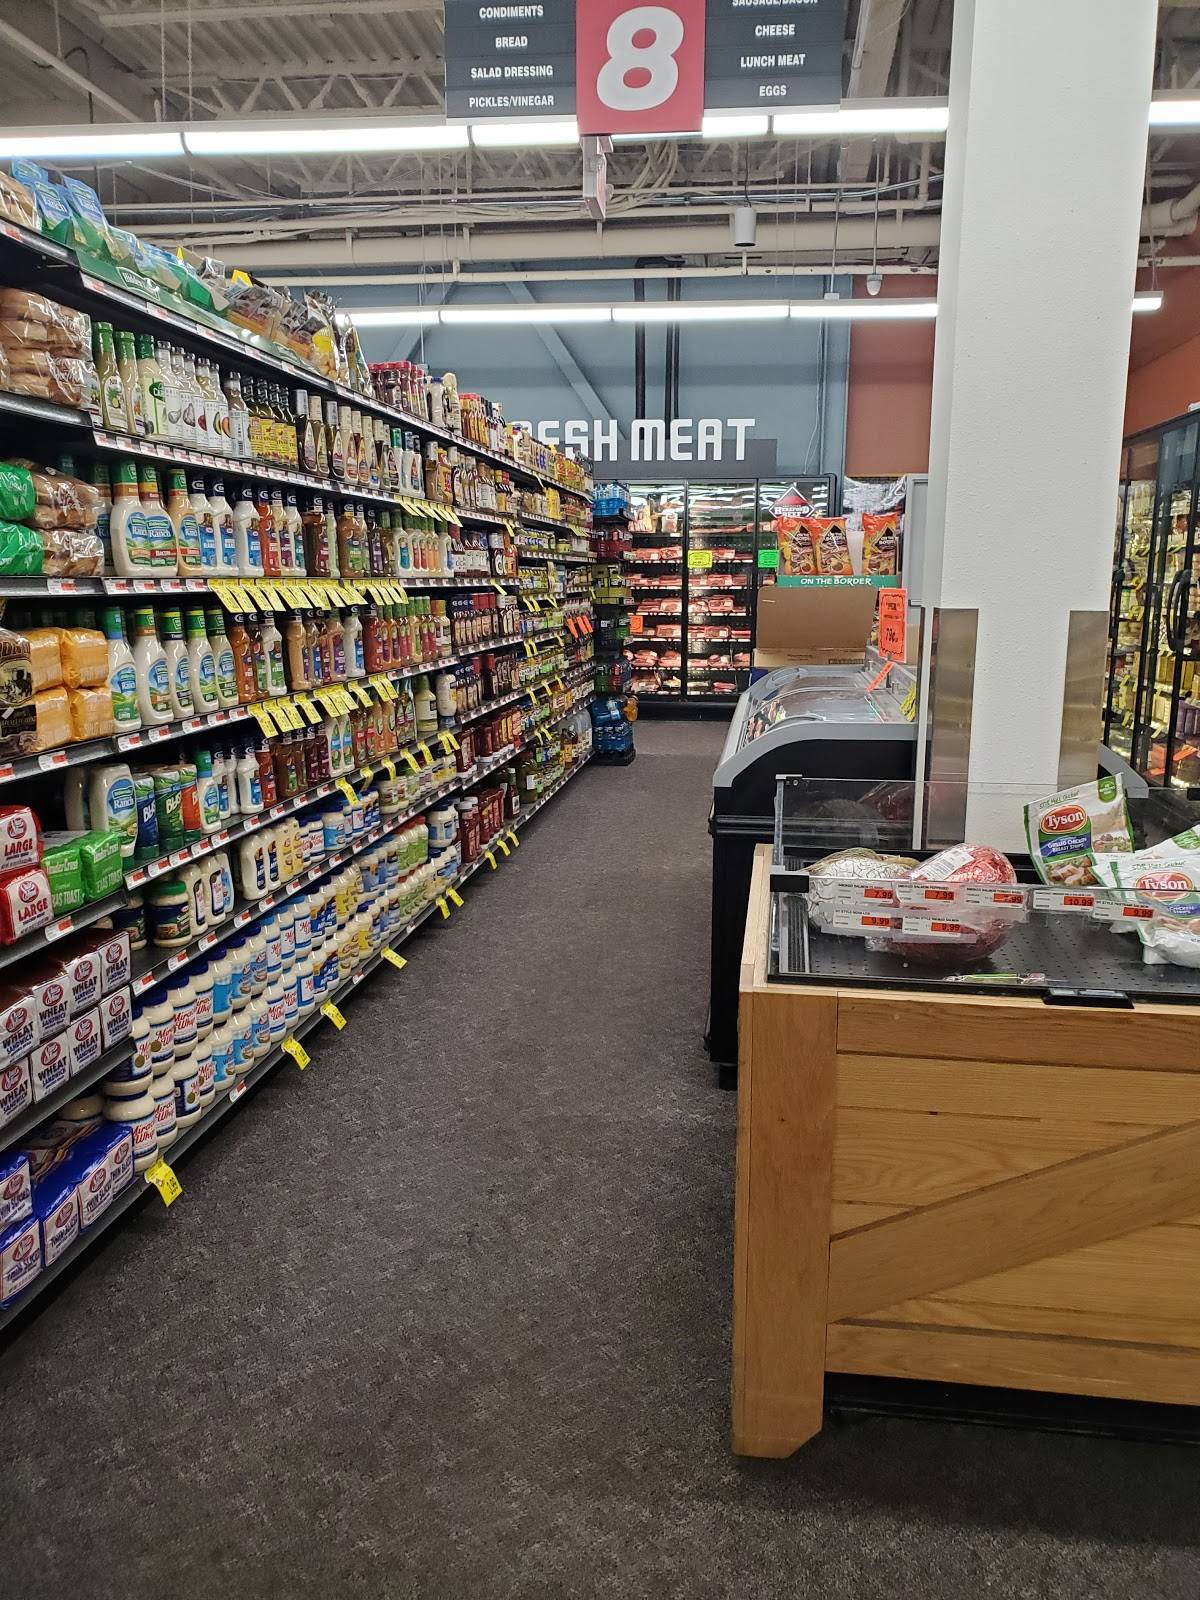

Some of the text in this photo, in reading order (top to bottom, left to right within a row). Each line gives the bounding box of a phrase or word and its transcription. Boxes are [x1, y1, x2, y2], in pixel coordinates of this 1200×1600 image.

[479, 5, 544, 19] CONDIMENTS
[755, 24, 796, 37] CHEESE
[495, 36, 528, 49] BREAD
[596, 6, 684, 111] 8
[740, 54, 806, 68] LUNCH MEAT
[470, 65, 553, 79] SALAD DRESSING
[759, 85, 787, 97] EGGS
[469, 95, 554, 109] PICKLES/VINEGAR
[511, 419, 756, 462] ESH MEAT
[150, 528, 171, 538] Ranch
[800, 577, 872, 587] ON THE BORDER
[114, 797, 135, 809] Ranch
[1045, 811, 1084, 829] Tyson
[4, 838, 33, 857] LARGE
[1141, 878, 1188, 896] Tyson
[873, 891, 893, 900] 7.99
[1070, 898, 1094, 907] 10.99
[17, 897, 49, 922] LARGE
[871, 917, 890, 926] 9.99
[941, 923, 960, 931] 9.99
[105, 957, 128, 977] WHEAT
[72, 976, 98, 996] WHEAT
[39, 1001, 68, 1021] WHEAT
[174, 1006, 197, 1021] Mirac
[106, 1009, 130, 1029] WHEAT
[2, 1021, 34, 1049] WHEAT
[73, 1033, 98, 1052] WHEAT
[38, 1056, 67, 1081] WHEAT
[0, 1080, 28, 1108] WHEAT
